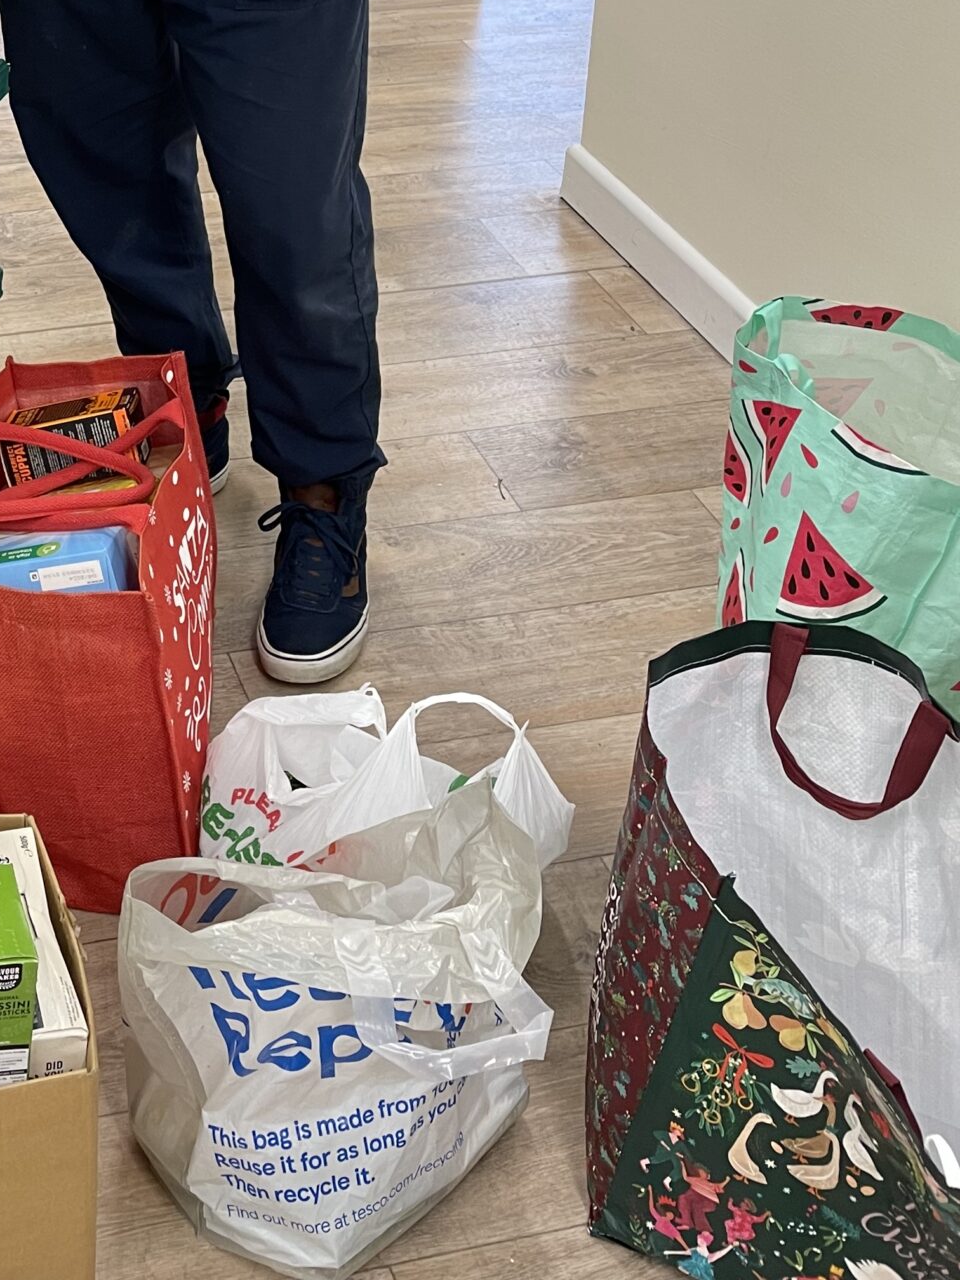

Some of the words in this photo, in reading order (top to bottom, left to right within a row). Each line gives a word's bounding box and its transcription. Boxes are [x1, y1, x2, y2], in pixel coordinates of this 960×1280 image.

[45, 1060, 64, 1071] DID
[208, 1124, 248, 1149] This
[252, 1127, 292, 1150] bag
[294, 1120, 312, 1141] is
[316, 1108, 374, 1137] made
[378, 1094, 426, 1119] from
[214, 1152, 275, 1176] Reuse
[279, 1156, 297, 1174] it
[300, 1150, 331, 1172] for
[337, 1144, 359, 1162] as
[363, 1128, 407, 1156] long
[409, 1115, 424, 1137] as
[220, 1173, 270, 1200] Then
[274, 1175, 350, 1205] recycle
[355, 1167, 376, 1186] it.
[226, 1204, 259, 1220] Find
[262, 1214, 288, 1227] out
[291, 1220, 331, 1235] more
[334, 1212, 350, 1231] at
